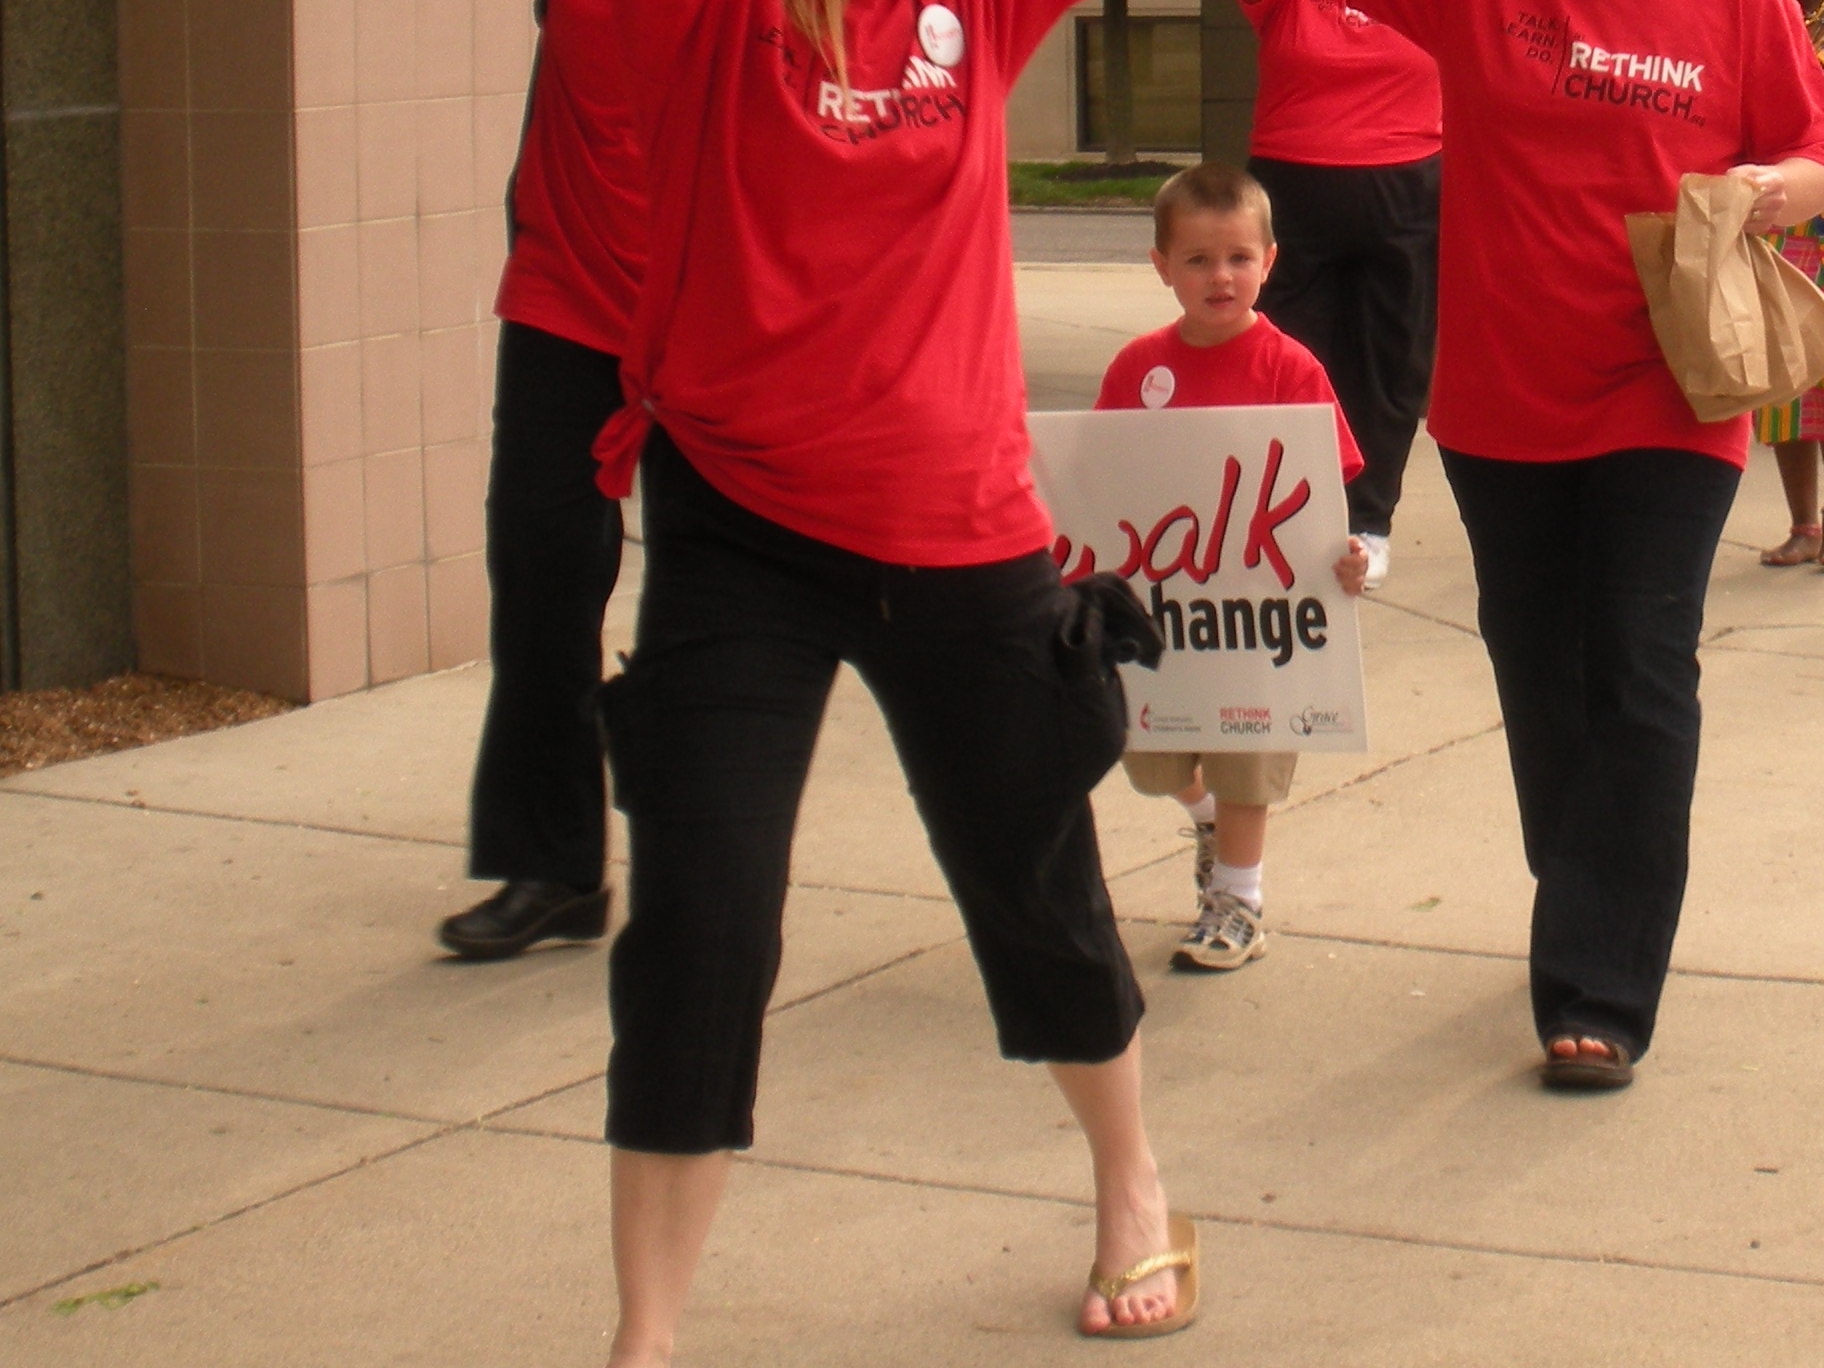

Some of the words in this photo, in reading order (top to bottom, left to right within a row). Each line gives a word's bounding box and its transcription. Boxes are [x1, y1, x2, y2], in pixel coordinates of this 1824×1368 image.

[1569, 41, 1705, 92] RETHINK
[1051, 437, 1311, 591] walk
[1220, 707, 1272, 722] RETHINK
[1220, 721, 1272, 734] CHURCH
